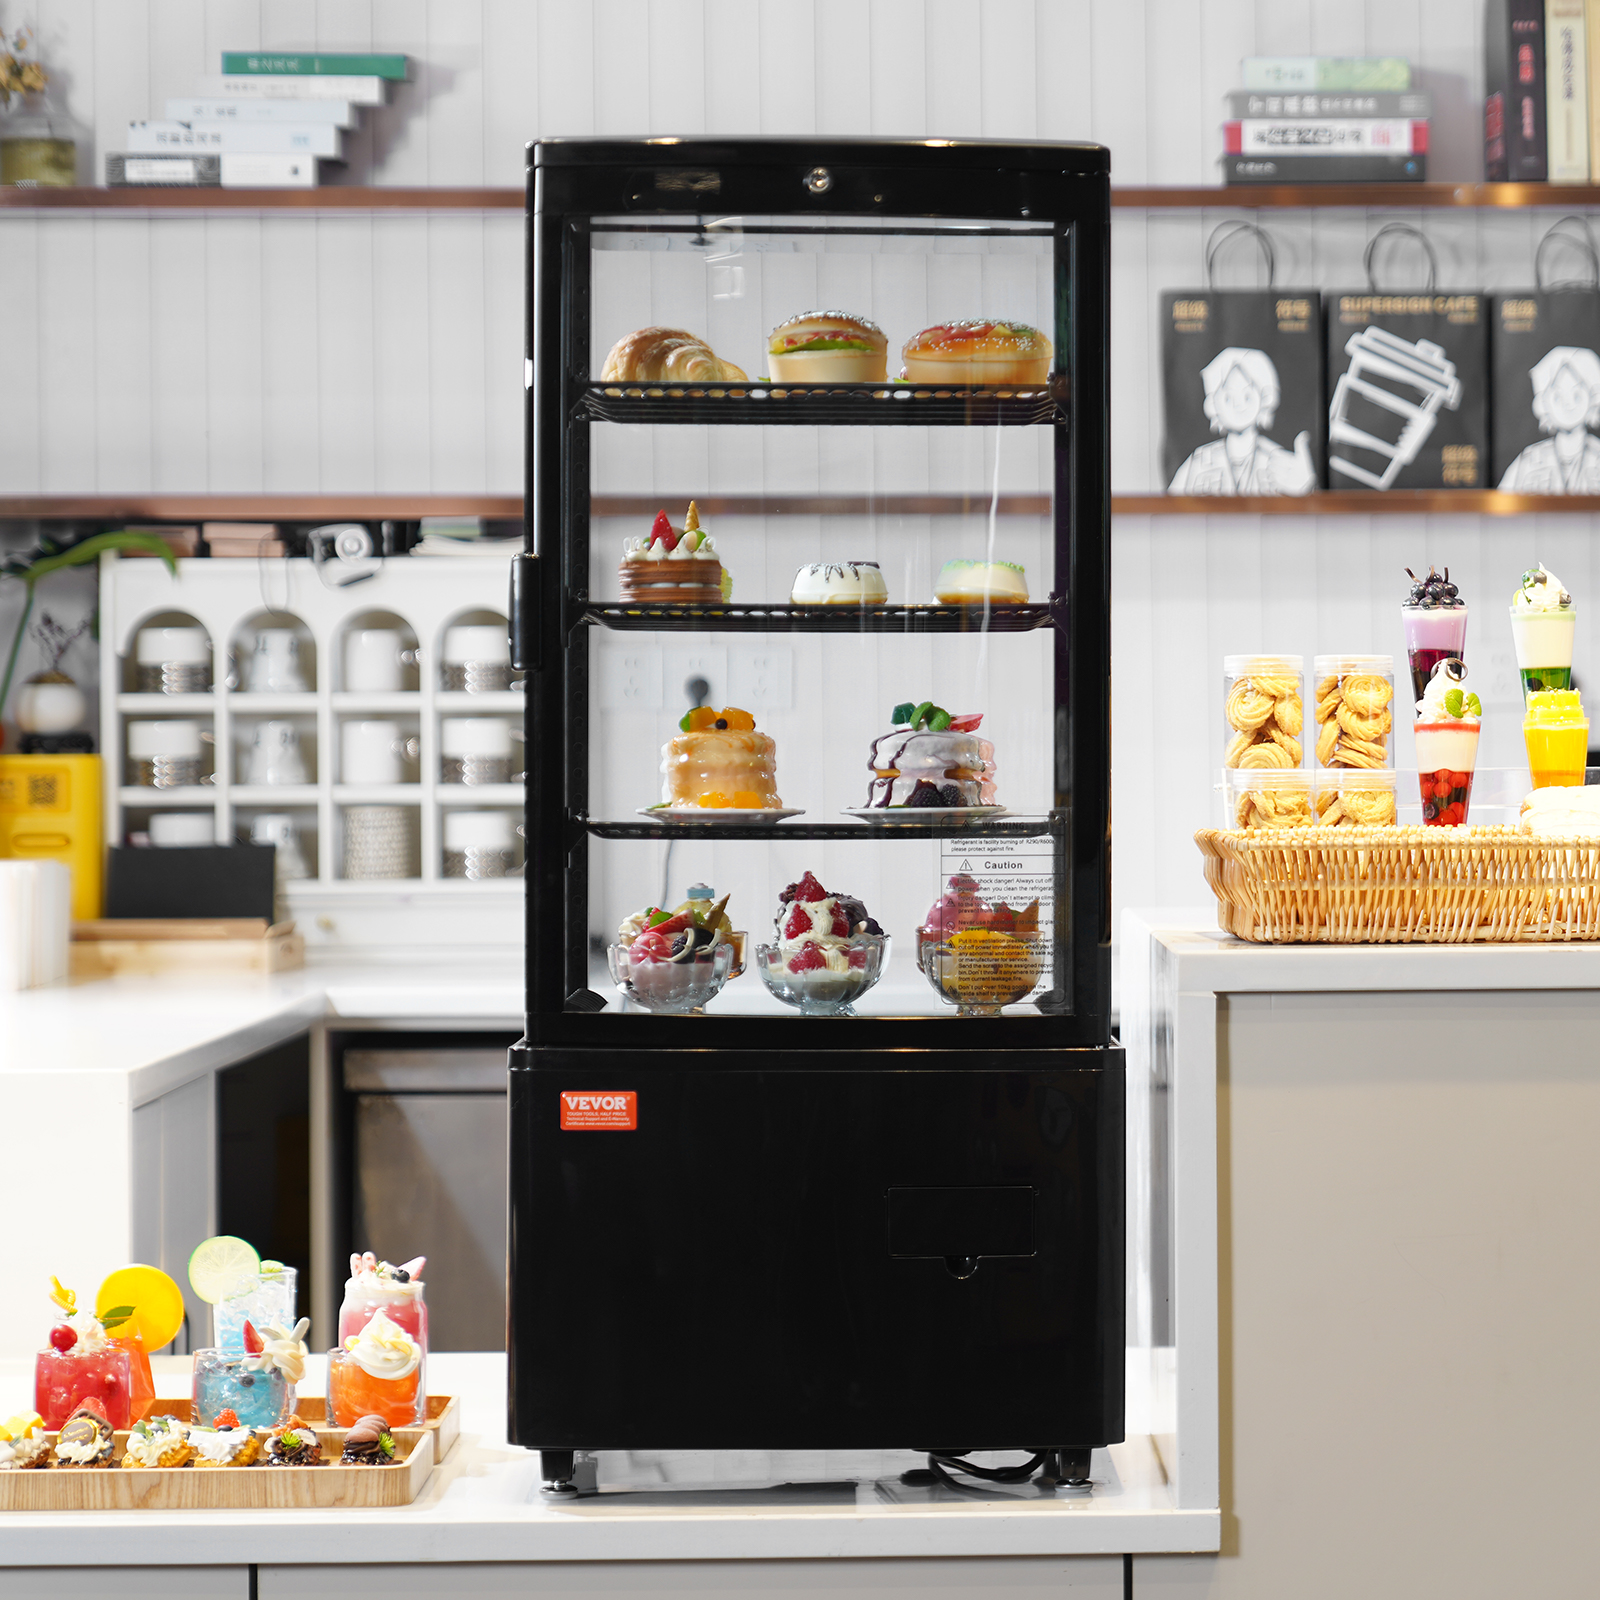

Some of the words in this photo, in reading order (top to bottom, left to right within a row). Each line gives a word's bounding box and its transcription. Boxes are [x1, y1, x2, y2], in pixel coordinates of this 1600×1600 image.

[982, 822, 1025, 830] WARNING
[984, 860, 1023, 870] Caution
[565, 1096, 627, 1110] VEVOR
